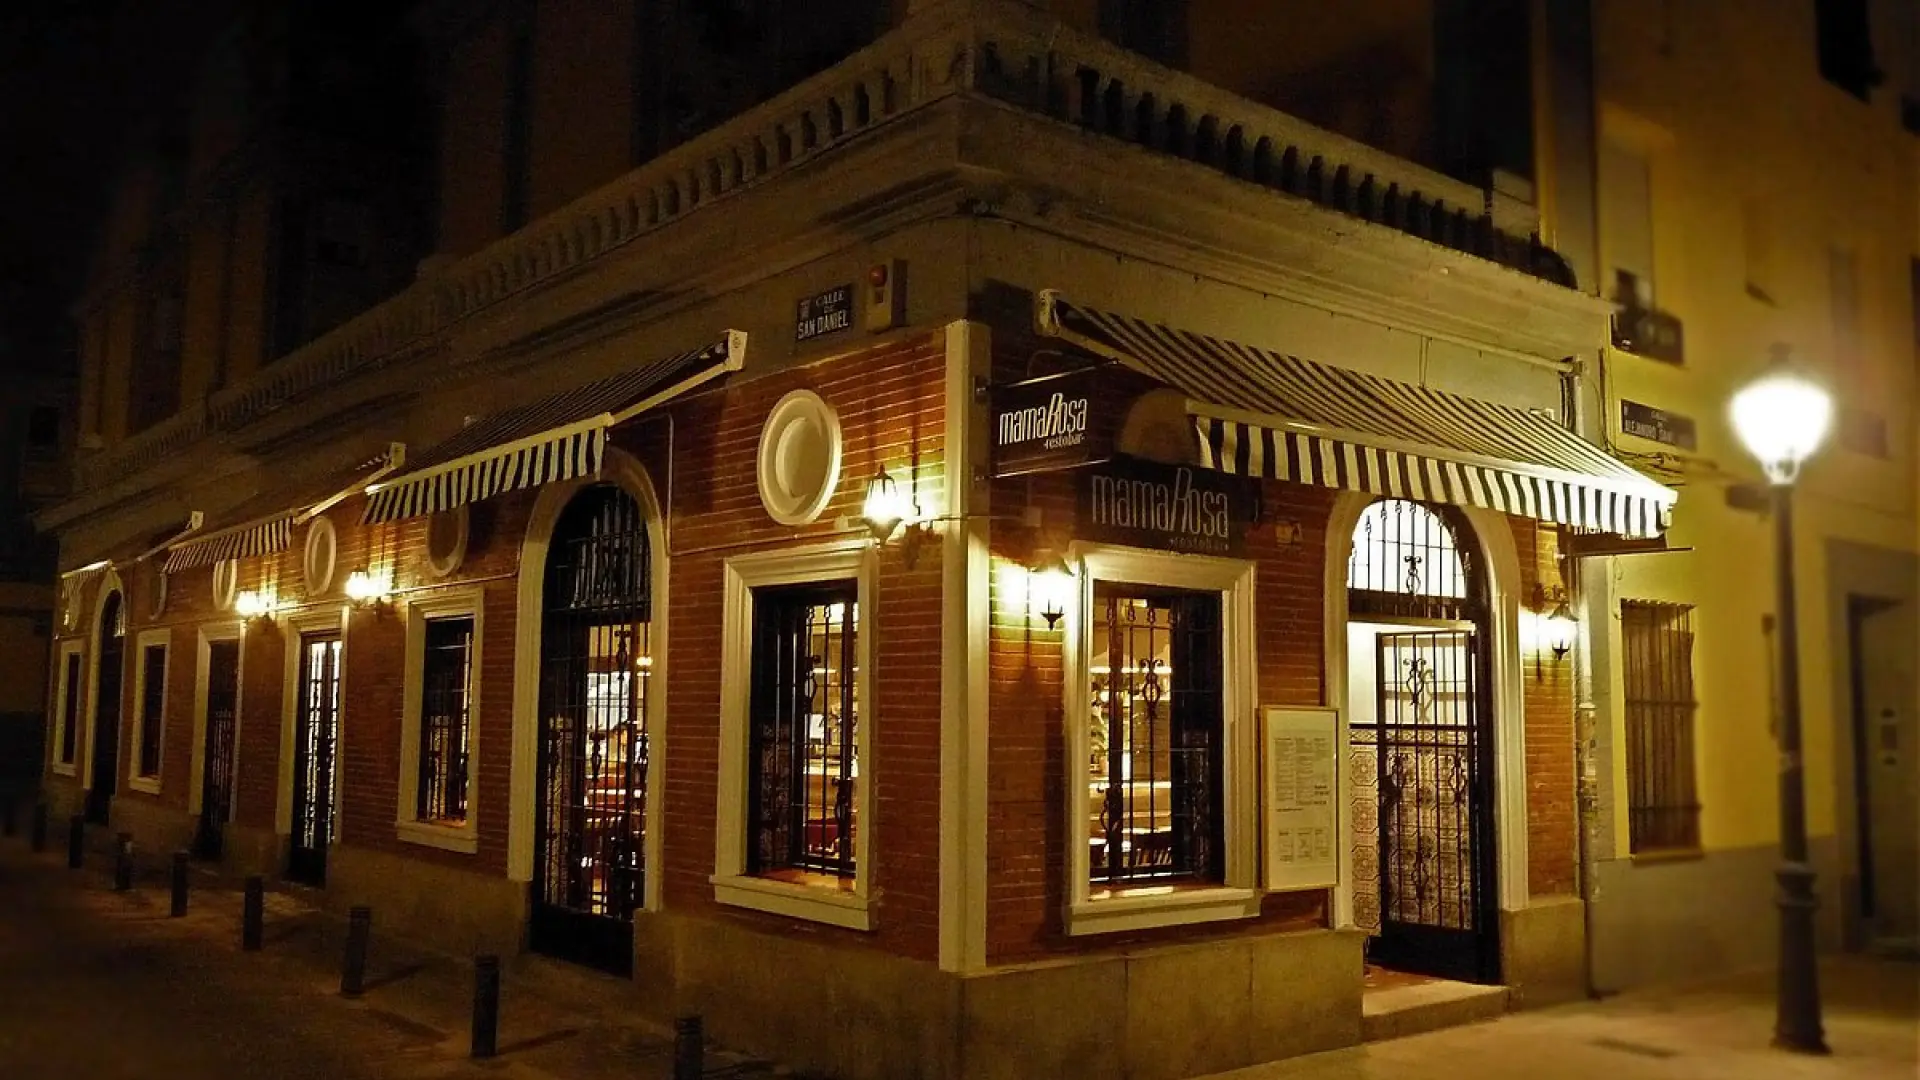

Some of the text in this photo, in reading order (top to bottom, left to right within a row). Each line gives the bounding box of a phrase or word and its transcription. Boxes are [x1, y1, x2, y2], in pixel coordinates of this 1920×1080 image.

[797, 308, 849, 340] SAN DANIEL
[999, 392, 1088, 446] mamaRosa
[1092, 467, 1229, 540] mamaRosa
